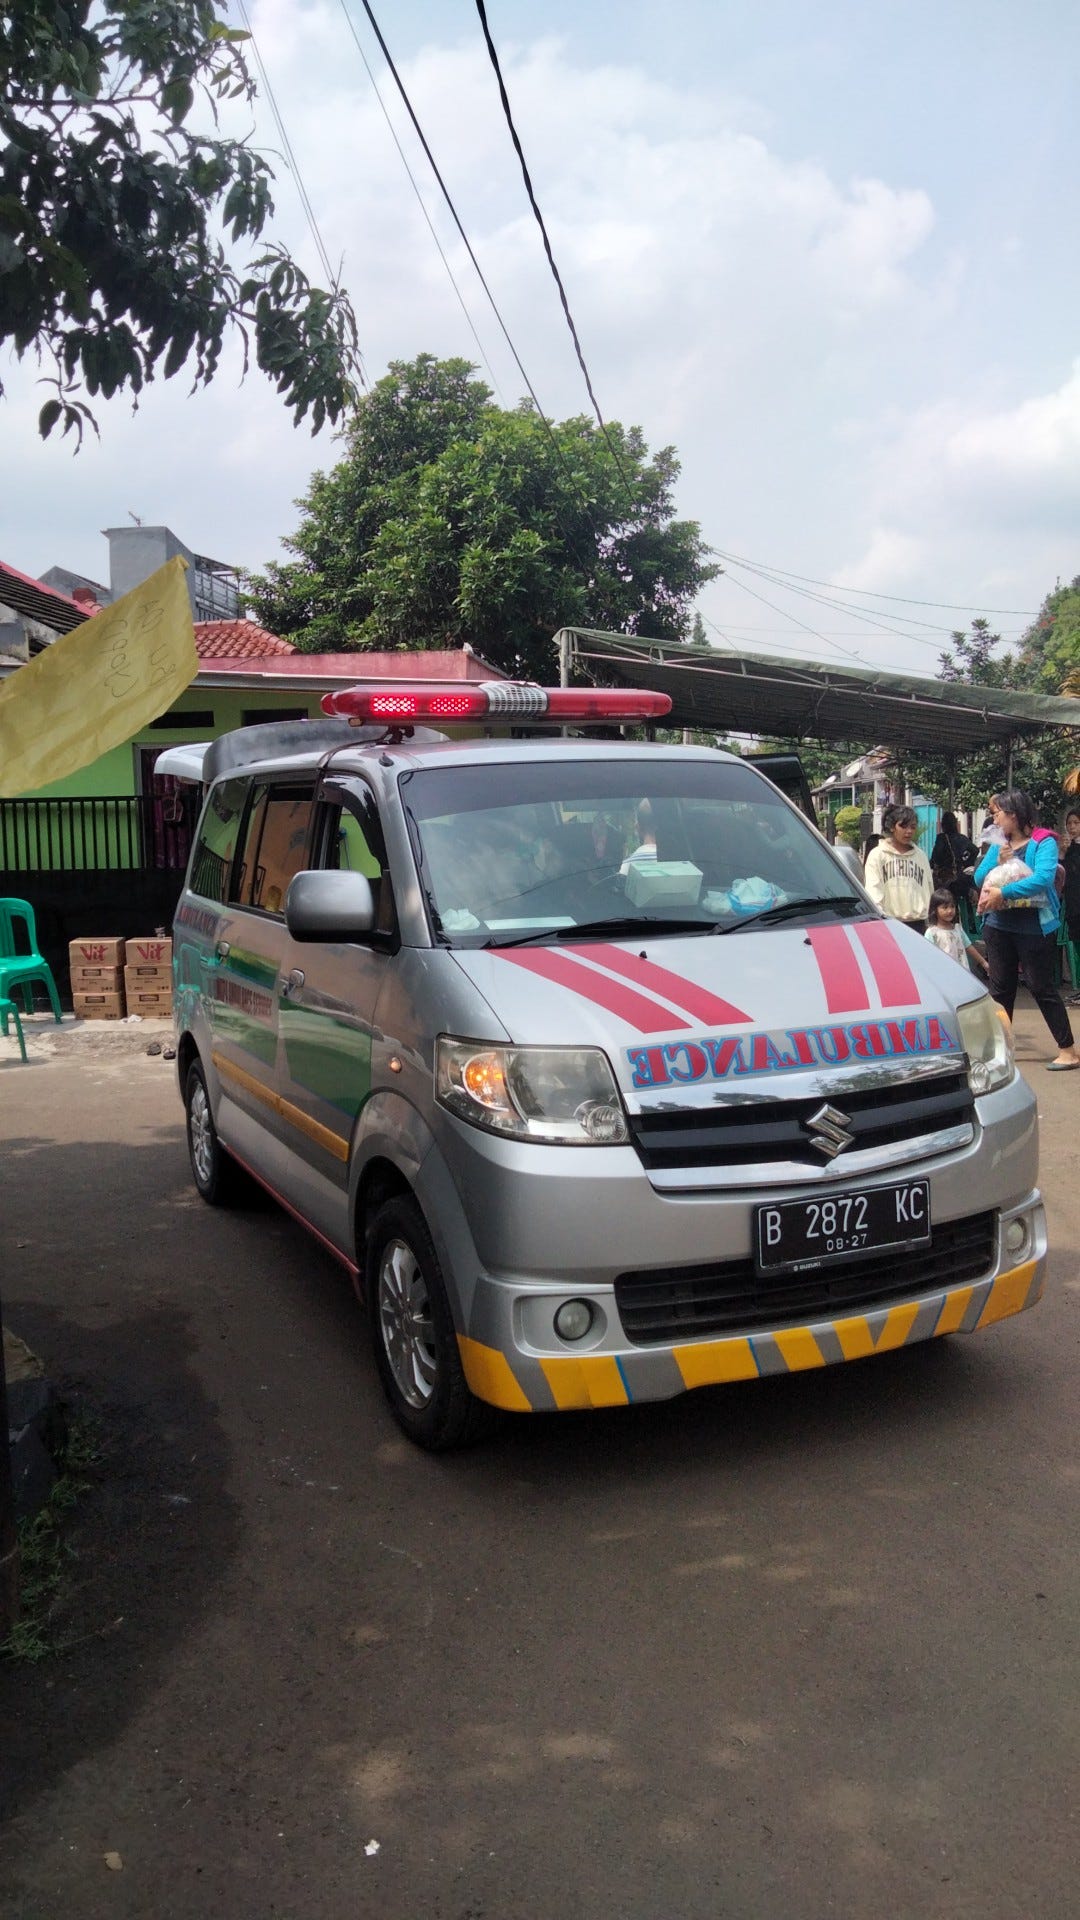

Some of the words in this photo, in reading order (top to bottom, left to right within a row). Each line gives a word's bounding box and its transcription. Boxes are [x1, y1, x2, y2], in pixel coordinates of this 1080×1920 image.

[80, 943, 108, 961] Vit
[136, 942, 166, 960] Vit
[766, 1210, 782, 1246] B
[805, 1196, 869, 1239] 2872
[895, 1187, 924, 1223] KC
